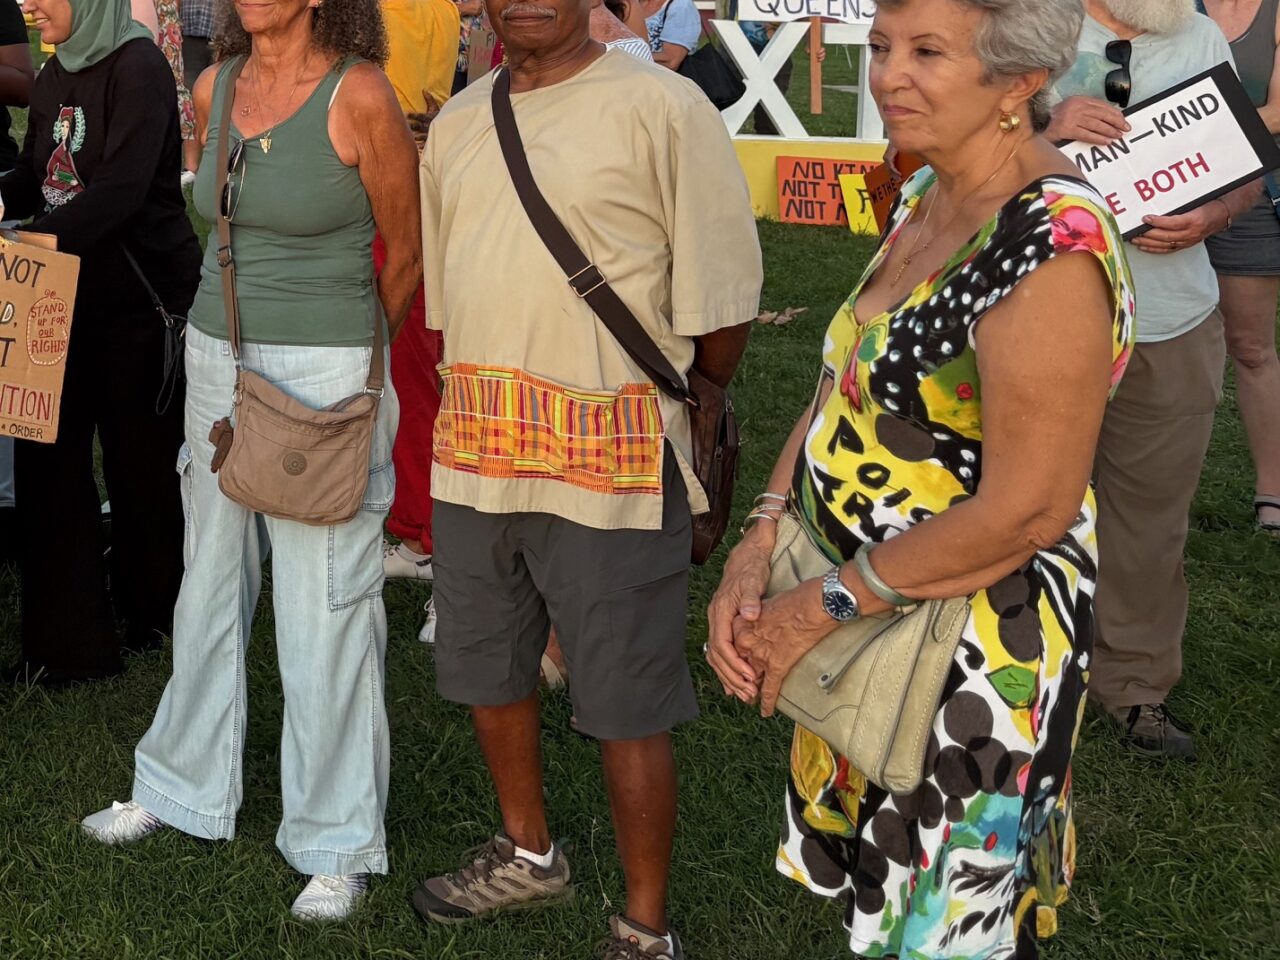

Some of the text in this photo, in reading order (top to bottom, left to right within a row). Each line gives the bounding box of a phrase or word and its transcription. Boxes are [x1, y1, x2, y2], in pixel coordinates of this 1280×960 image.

[792, 161, 825, 180] NO
[1133, 152, 1211, 202] BOTH
[782, 180, 820, 198] NOT
[785, 199, 826, 220] NOT
[30, 302, 65, 318] STAND
[8, 423, 44, 440] ORDER
